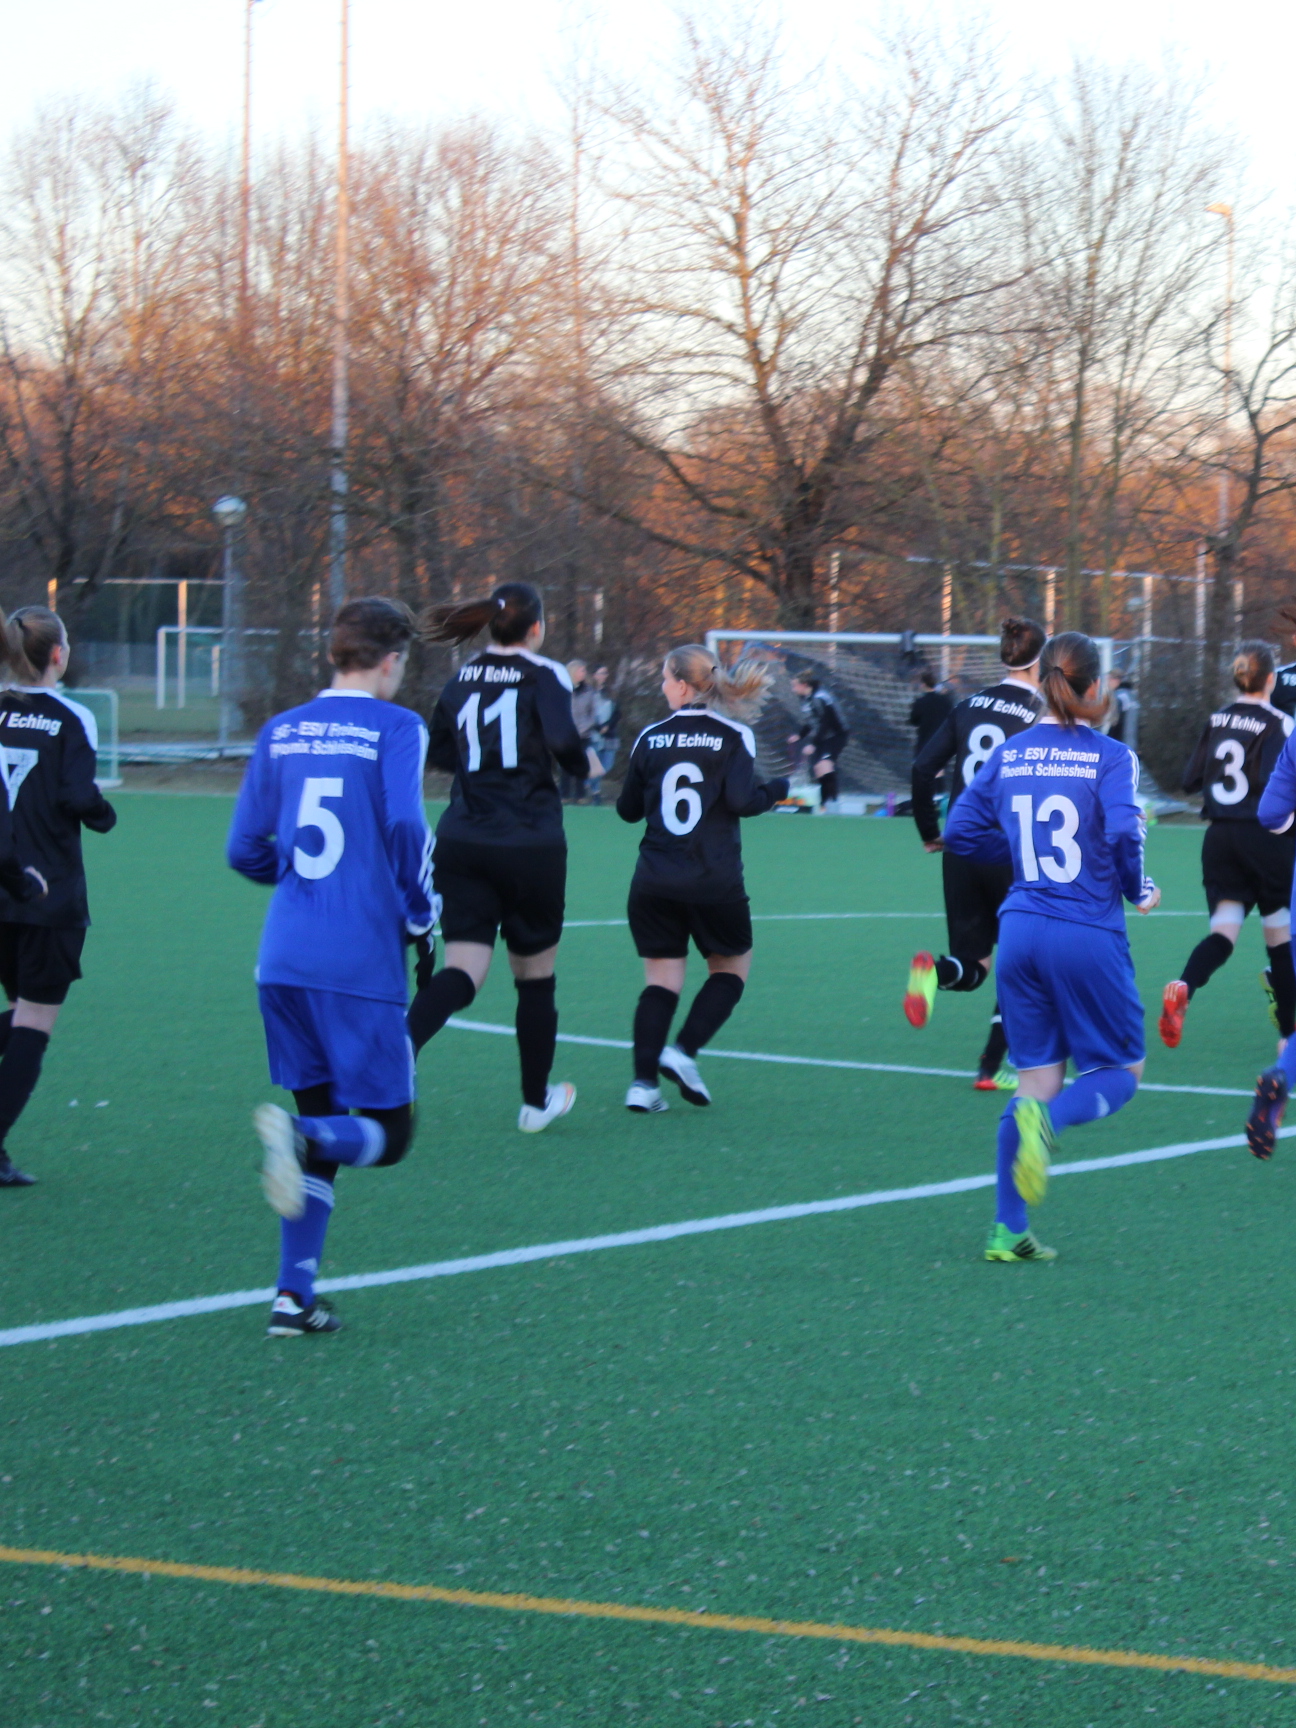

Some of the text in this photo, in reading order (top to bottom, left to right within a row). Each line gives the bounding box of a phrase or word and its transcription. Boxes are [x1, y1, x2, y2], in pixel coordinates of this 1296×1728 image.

[484, 665, 524, 684] Echin
[7, 712, 62, 737] Eching
[457, 687, 519, 773] 11
[968, 695, 1036, 724] TSV Eching
[647, 732, 723, 752] TSV Eching
[962, 723, 1006, 787] 8
[1002, 749, 1018, 764] SG
[1024, 747, 1049, 761] ESV
[1050, 747, 1101, 764] Freimann
[1001, 762, 1098, 780] Phoenix Schleissheim
[1211, 739, 1250, 806] 3
[661, 761, 704, 836] 6
[293, 777, 345, 880] 5
[1011, 794, 1082, 884] 13
